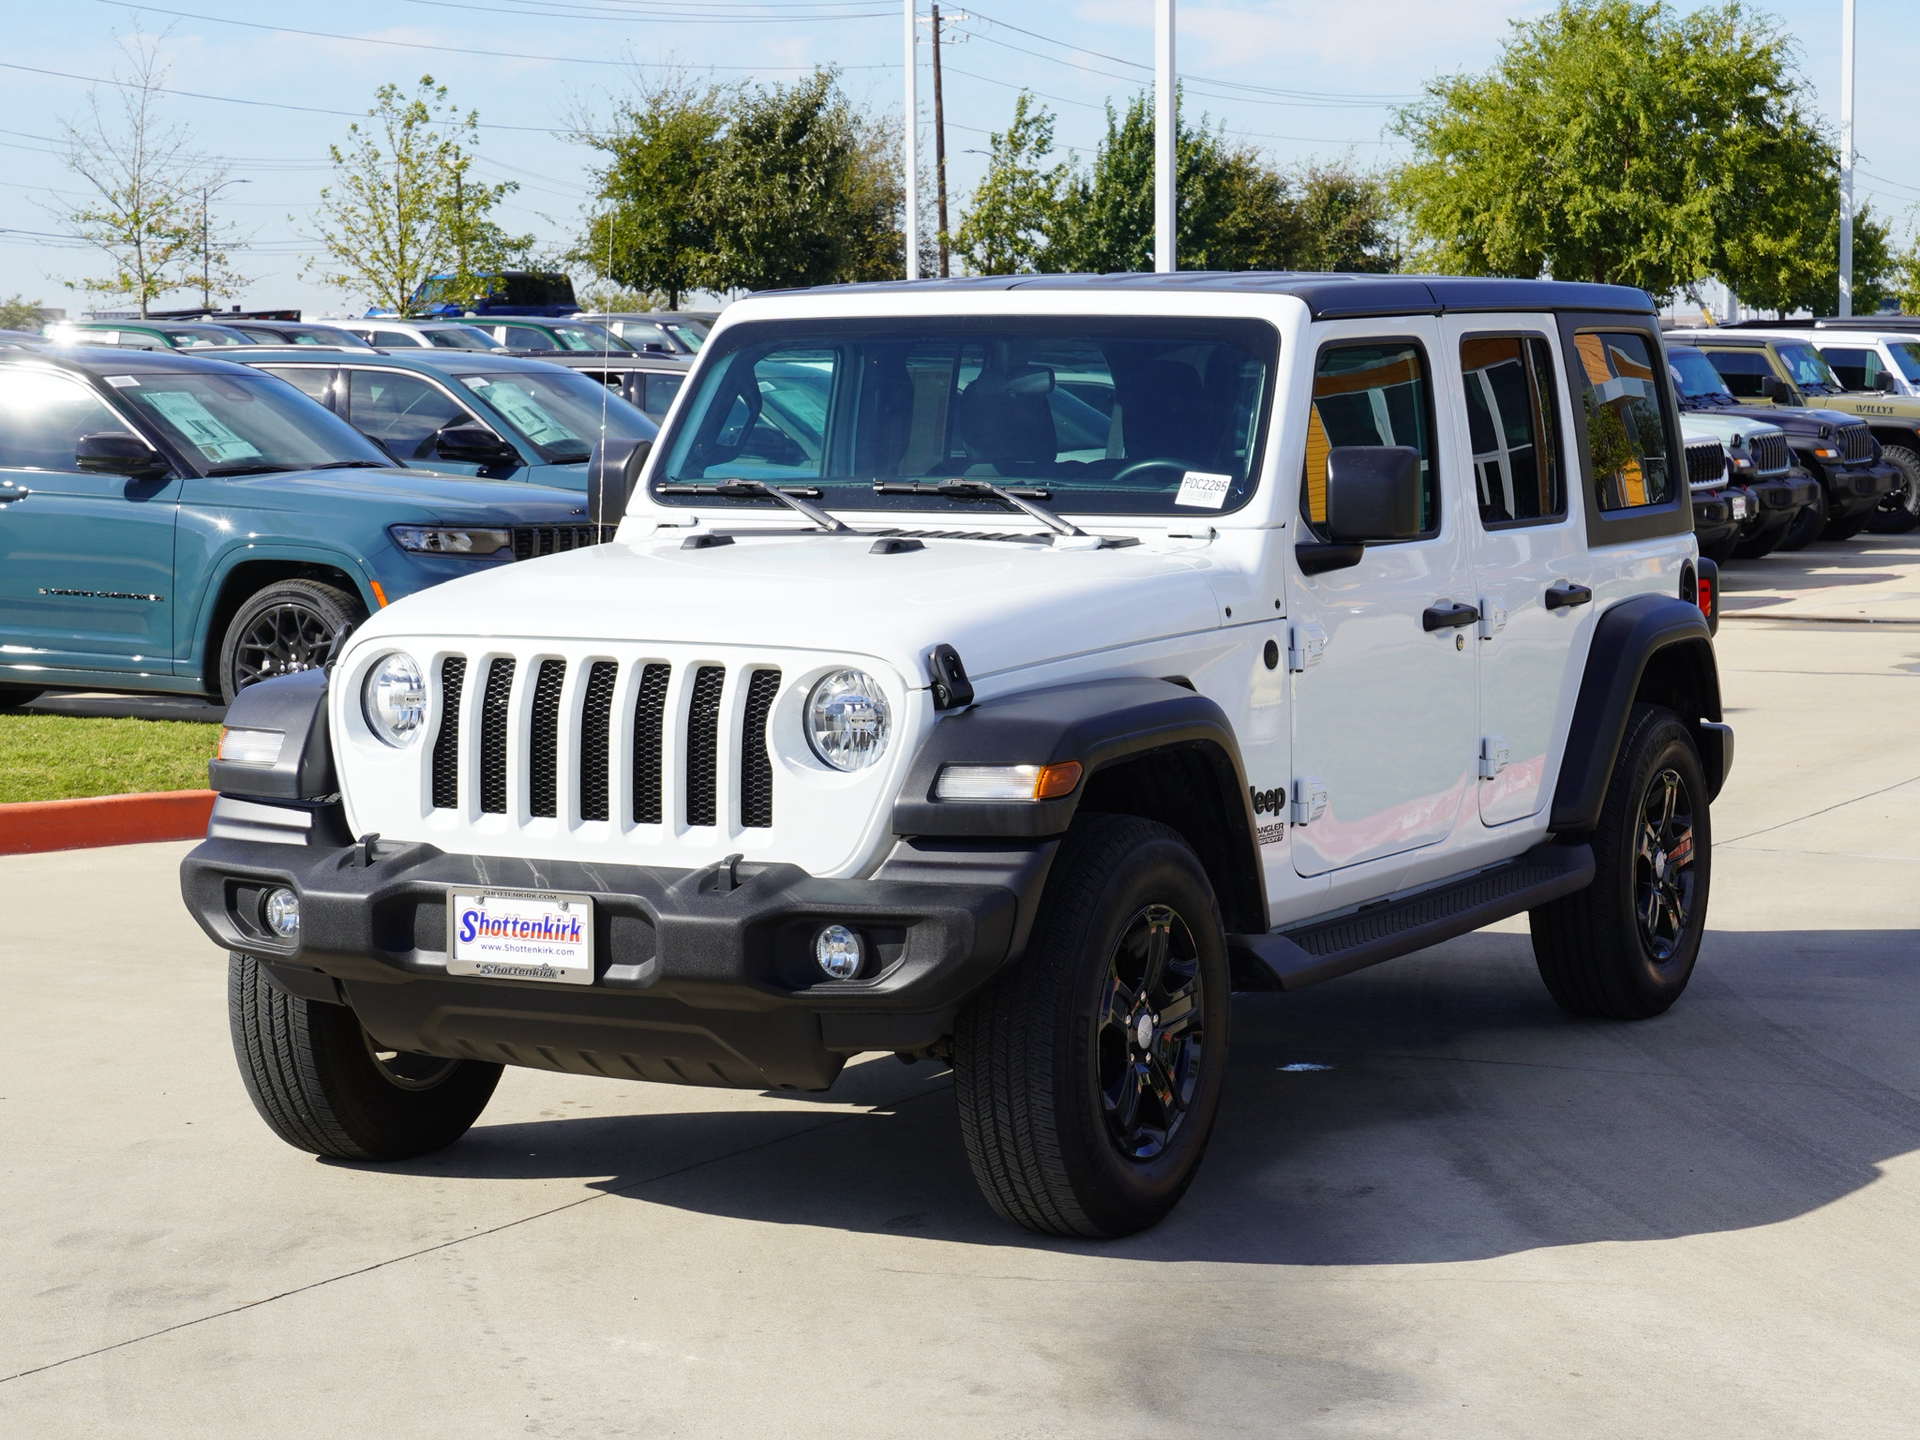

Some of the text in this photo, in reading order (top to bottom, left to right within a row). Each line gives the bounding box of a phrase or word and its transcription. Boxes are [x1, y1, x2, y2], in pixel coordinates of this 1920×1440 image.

[1856, 404, 1895, 414] WILLYS
[1183, 477, 1229, 492] PDC2285
[1257, 822, 1284, 834] ANGLER
[483, 890, 557, 900] SHOTTENKIRK.COM
[459, 910, 582, 943] Shottenkirk
[480, 943, 575, 956] www.Shottenkirk.com
[480, 964, 557, 979] Shottenkirk
